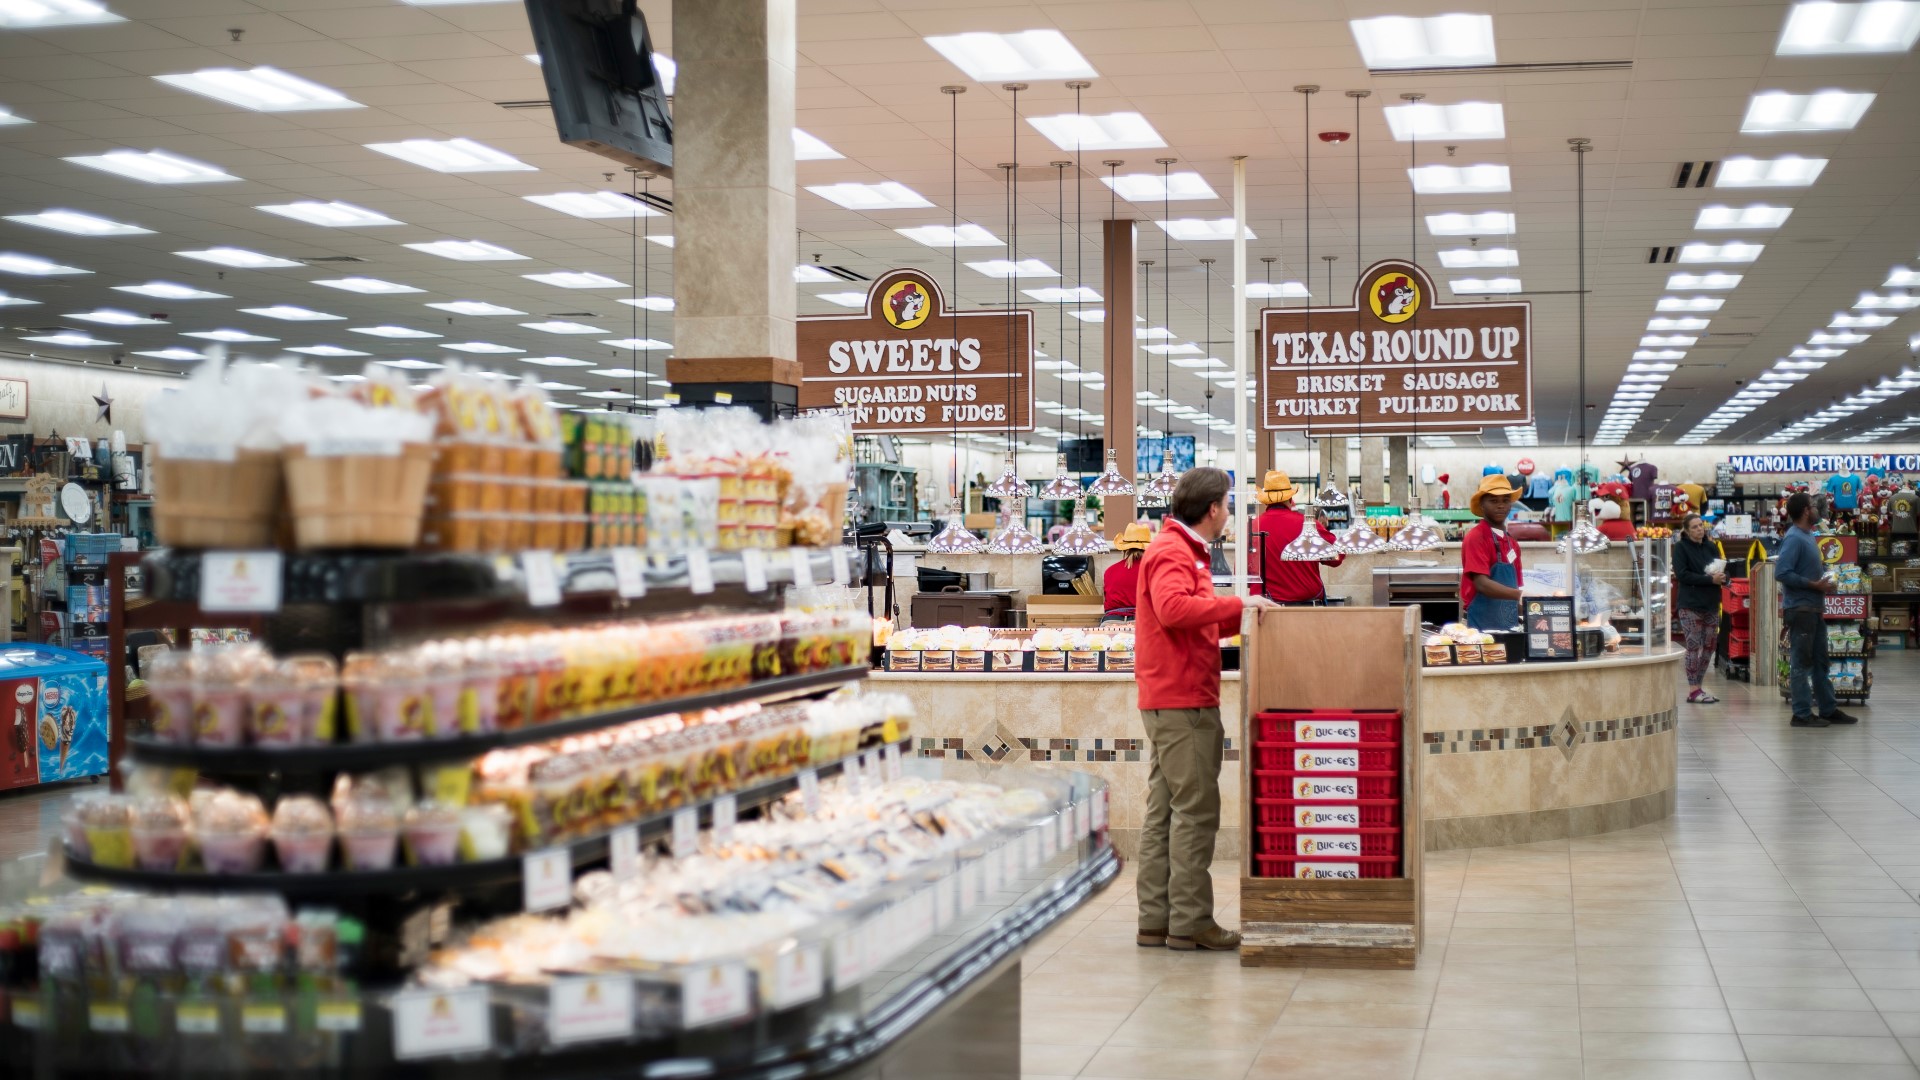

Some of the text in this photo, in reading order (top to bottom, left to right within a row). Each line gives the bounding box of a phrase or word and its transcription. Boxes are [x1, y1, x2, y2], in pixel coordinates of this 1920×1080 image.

[1272, 326, 1520, 364] TEXAS ROUND UP
[828, 338, 981, 374] SWEETS
[1296, 371, 1499, 394] BRISKET SAUSAGE
[834, 384, 977, 404] SUGARED NUTS
[877, 405, 926, 423] DOTS
[942, 404, 1006, 422] FUDGE
[1275, 394, 1521, 416] TURKEY PULLED PORK
[1732, 456, 1806, 473] MAGNOLIA
[1823, 606, 1864, 615] SNACKS
[1315, 728, 1357, 738] BUC-EE'S
[1314, 757, 1356, 768] BUC-EE'S
[1313, 785, 1355, 795] BUC-EE'S
[1315, 813, 1356, 824] BUC-EE'S
[1316, 842, 1358, 852] BUC-EE'S
